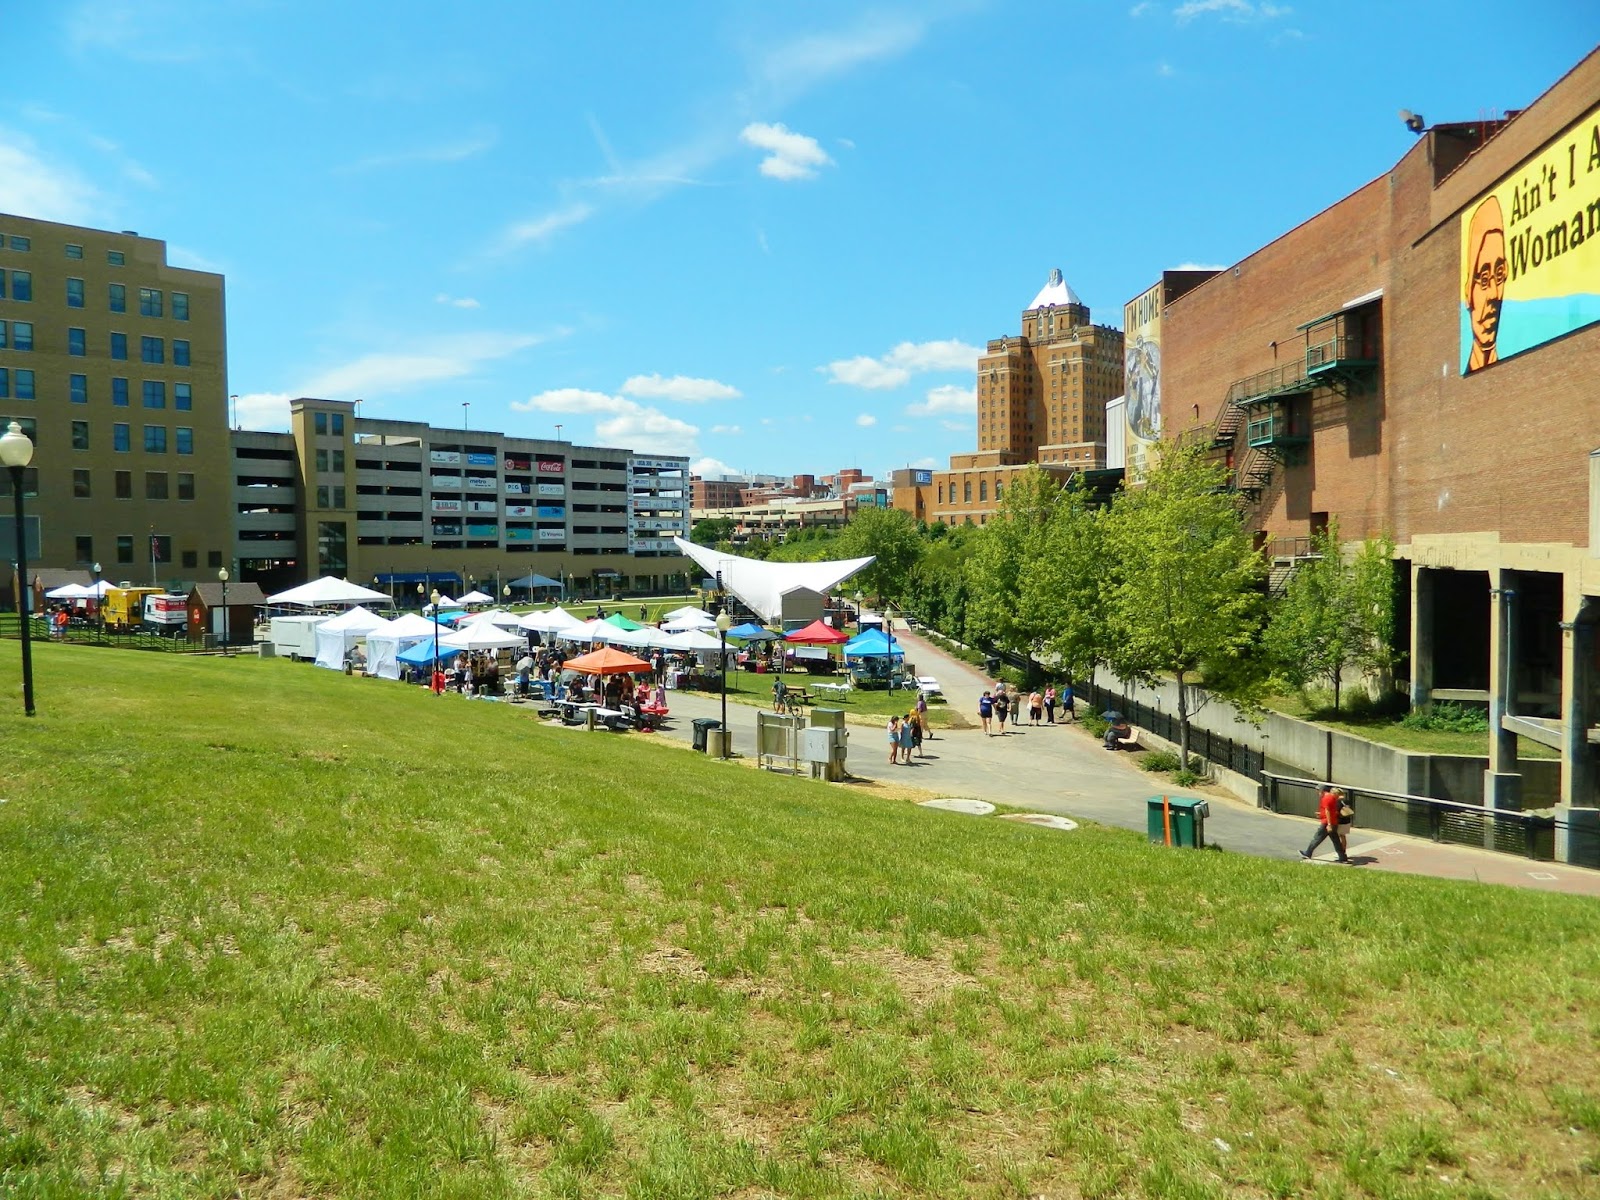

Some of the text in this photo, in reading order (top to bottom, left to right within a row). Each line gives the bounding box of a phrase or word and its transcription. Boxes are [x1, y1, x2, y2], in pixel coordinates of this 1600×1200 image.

[1510, 124, 1600, 227] Ain't I A
[1510, 196, 1600, 281] Woman
[1138, 287, 1159, 327] HOME
